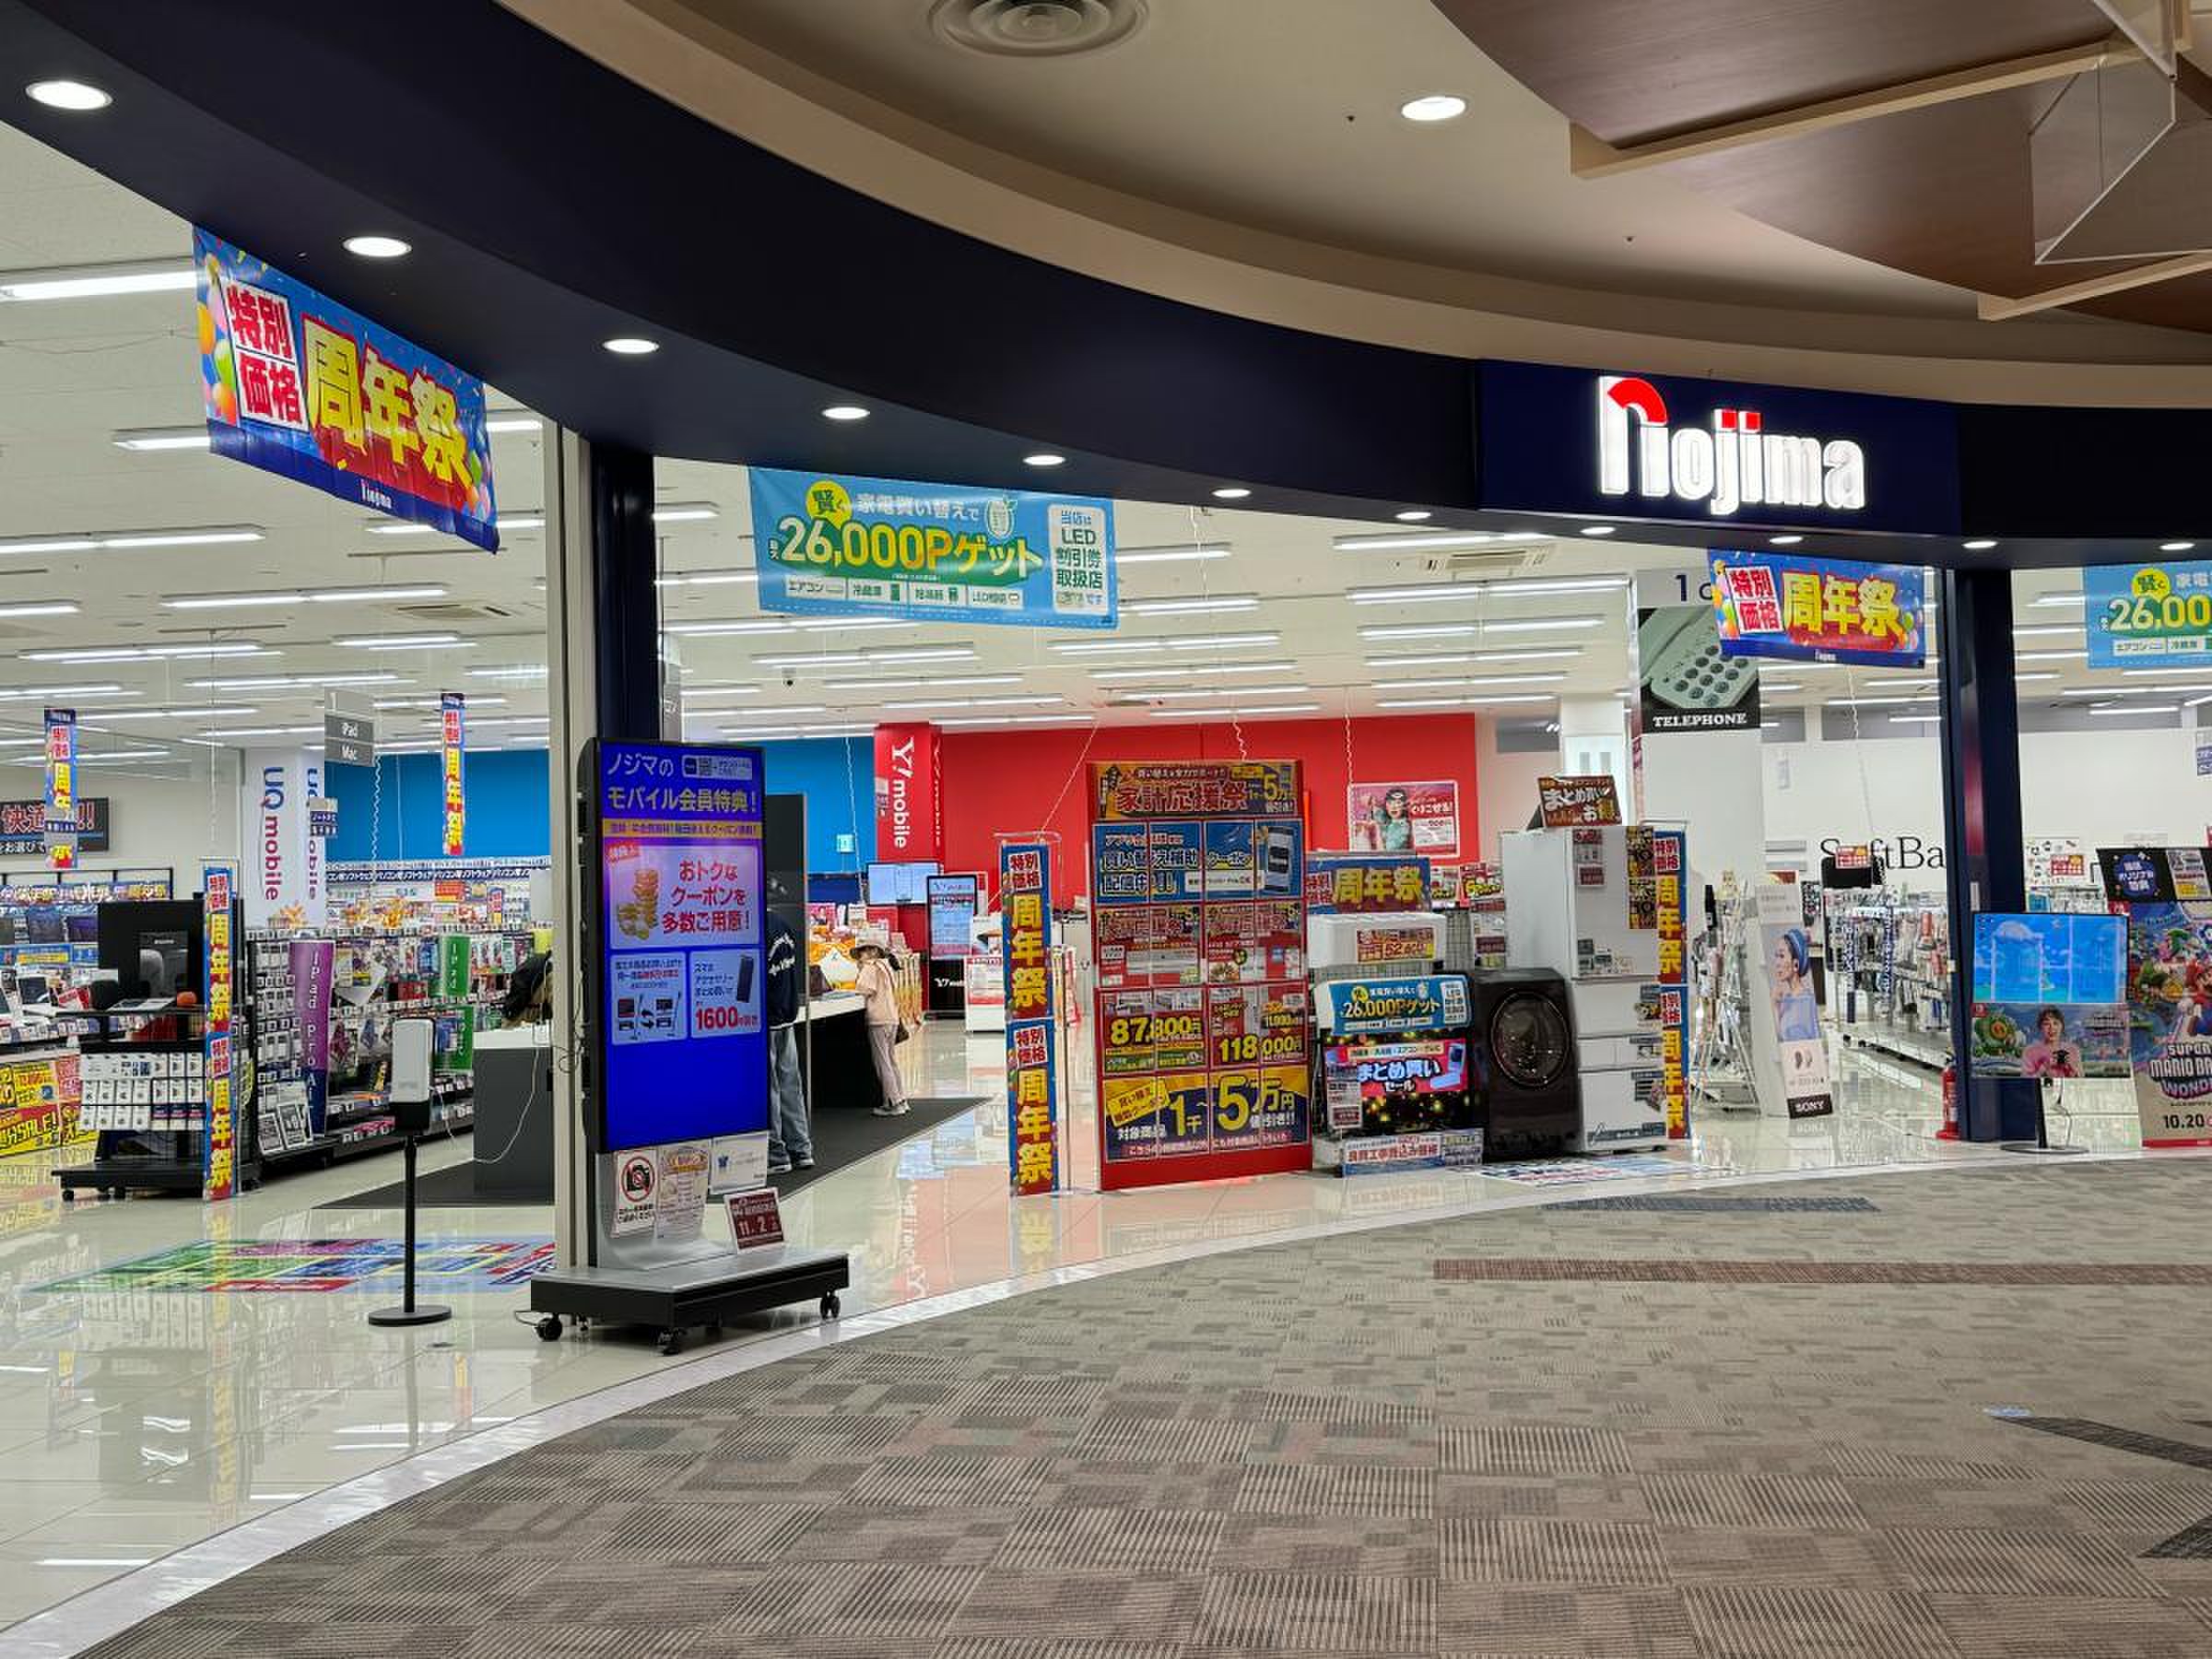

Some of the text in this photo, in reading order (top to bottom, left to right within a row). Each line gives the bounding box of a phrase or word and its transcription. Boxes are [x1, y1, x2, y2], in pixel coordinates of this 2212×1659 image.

[227, 287, 292, 359] 特別
[240, 354, 303, 425] 価格
[303, 313, 475, 488] 周年祭
[1599, 376, 1865, 515] nojima
[778, 515, 1043, 578] 26,000Pゲット
[1061, 529, 1097, 545] LED
[1055, 548, 1101, 568] 割引券
[1056, 569, 1103, 590] 取扱店
[1732, 570, 1772, 597] 特別
[2175, 571, 2212, 588] 家電
[1739, 600, 1781, 630] 価格
[1783, 572, 1907, 637] 周年祭
[1652, 712, 1747, 728] TELEPHONE
[606, 752, 675, 778] ノジマの
[891, 737, 914, 849] Y!mobile
[1542, 786, 1612, 812] まとめ買い
[263, 767, 285, 900] UQ mobile
[1008, 853, 1037, 872] 特別
[1819, 836, 1946, 870] SftBa
[308, 839, 318, 900] obile
[678, 859, 738, 882] おトクな
[1013, 871, 1041, 888] 価格
[670, 885, 747, 907] クーポンを
[1334, 866, 1423, 903] 周年祭
[662, 910, 751, 935] 多数ご用意!
[1657, 876, 1682, 974] 周年祭
[1010, 894, 1048, 1008] 周年祭
[1016, 1027, 1044, 1046] 特別
[1018, 1045, 1046, 1065] 価格
[2150, 1058, 2194, 1077] MARIO
[1357, 1060, 1441, 1082] まとめ買い
[1385, 1078, 1416, 1092] セール
[2161, 1077, 2212, 1097] WOND
[1794, 1100, 1824, 1112] SONY
[1017, 1068, 1053, 1184] 周年祭
[2162, 1114, 2206, 1130] 10.20
